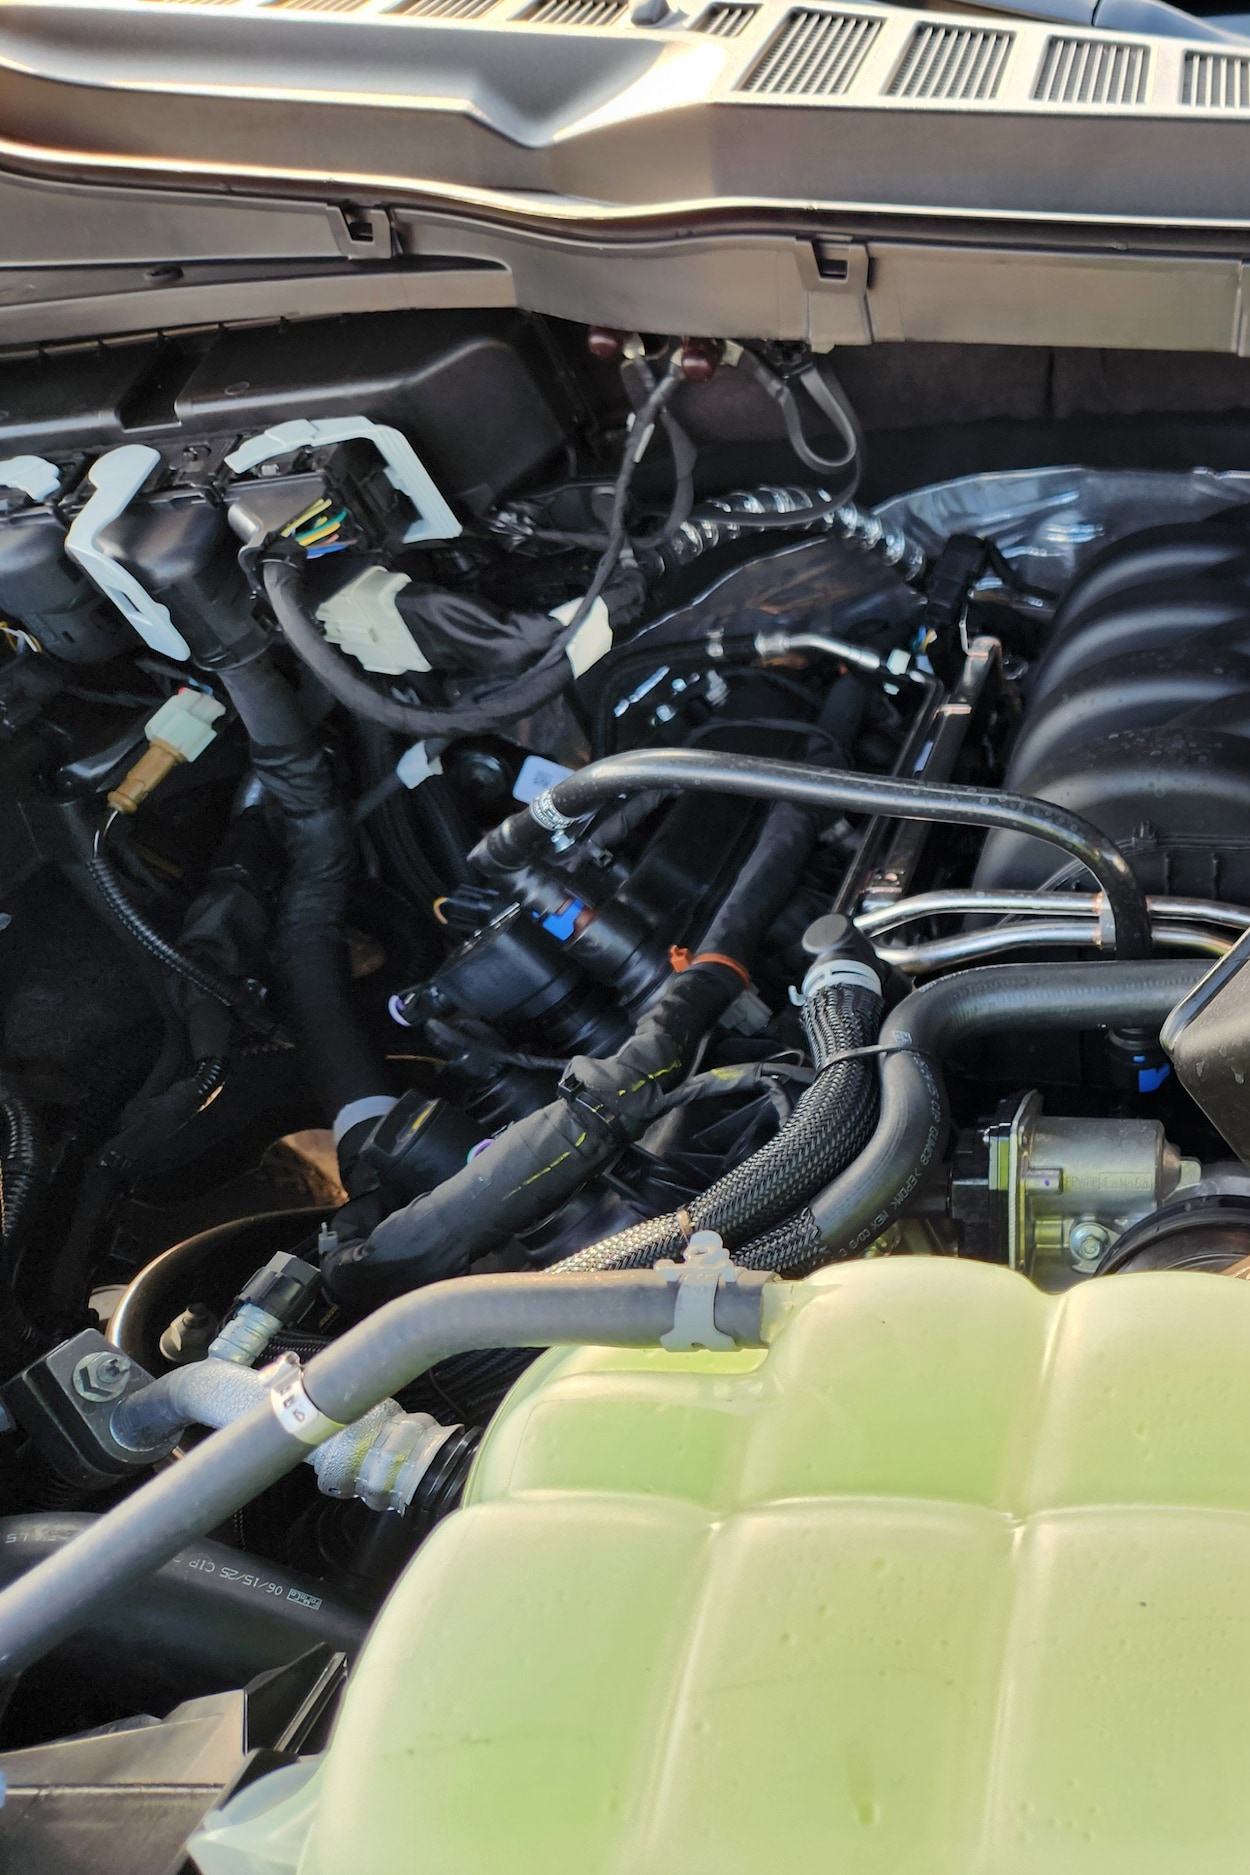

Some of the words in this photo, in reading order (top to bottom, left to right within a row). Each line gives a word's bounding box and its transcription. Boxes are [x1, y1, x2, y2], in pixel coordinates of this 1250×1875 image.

[870, 1209, 889, 1230] MEX
[188, 1559, 216, 1573] CIP
[220, 1566, 284, 1596] 06/15/25
